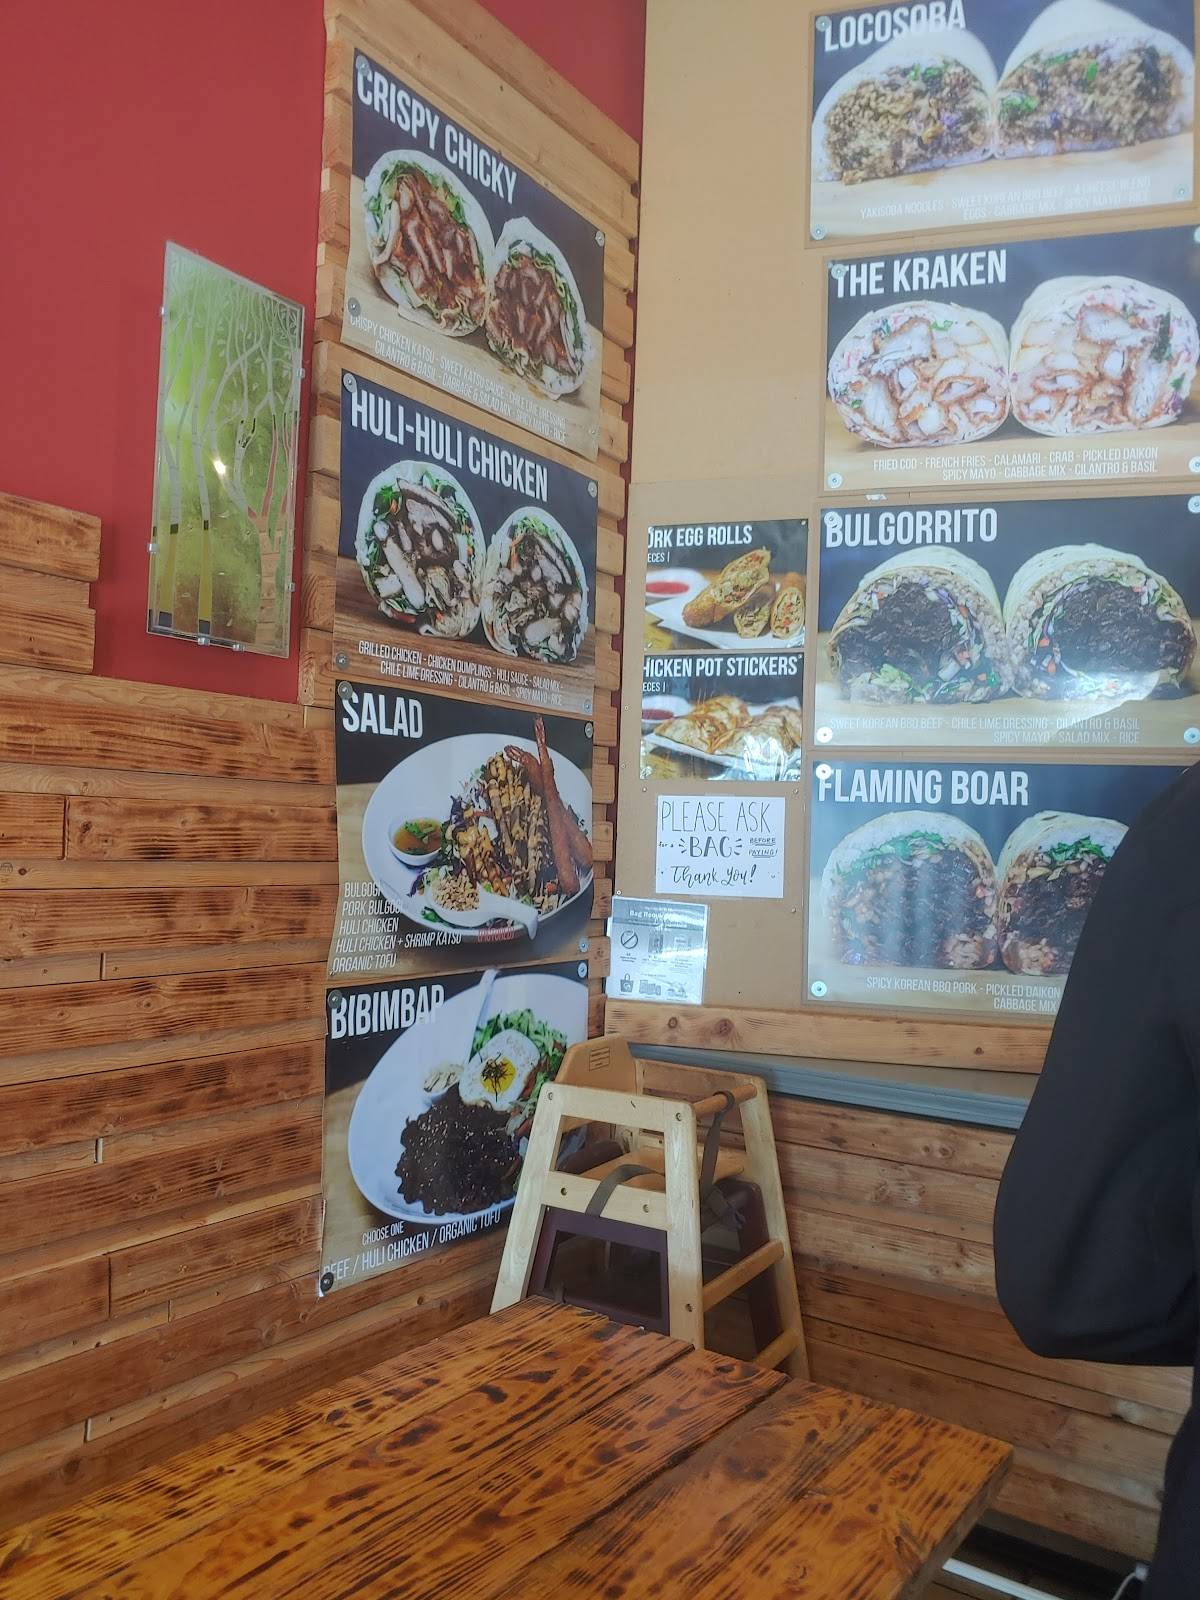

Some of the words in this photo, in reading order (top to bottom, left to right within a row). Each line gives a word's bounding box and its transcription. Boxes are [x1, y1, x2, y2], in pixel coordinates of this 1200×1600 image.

[825, 0, 966, 52] LOCOSOBA
[357, 68, 440, 151] CRISPY
[445, 124, 517, 205] CHICKY
[832, 262, 885, 298] THE
[893, 249, 1007, 293] KRAKEN
[379, 326, 410, 352] CHICKEN
[412, 342, 435, 363] KATSU
[440, 356, 463, 377] SWEET
[464, 367, 485, 387] KATSU
[375, 340, 411, 368] CILANTRO
[411, 360, 417, 371] &
[417, 361, 437, 381] BASIL
[442, 373, 473, 400] CABBAGE
[479, 391, 500, 411] SALAD
[351, 387, 463, 469] HULI-HULI
[468, 436, 547, 502] CHICKEN
[873, 459, 898, 471] FRIED
[900, 458, 917, 470] COD
[925, 456, 959, 469] FRENCH
[961, 455, 985, 468] FRIES
[994, 451, 1041, 466] CALAMARI
[1049, 450, 1074, 463] CRAB
[1082, 448, 1121, 462] PICKLED
[1123, 446, 1159, 460] DAIKON
[942, 469, 968, 481] SPICY
[969, 467, 996, 480] MAYO
[1004, 465, 1046, 479] CABBAGE
[1048, 465, 1066, 477] MIX
[1074, 461, 1119, 475] CILANTRO
[1122, 461, 1128, 474] &
[1130, 460, 1157, 473] BASIL
[676, 527, 704, 547] EGG
[707, 525, 753, 546] ROLLS
[825, 508, 998, 548] BULGORRITO
[359, 640, 390, 659] GRILLED
[391, 646, 422, 665] CHICKEN
[427, 654, 456, 671] CHICKEN
[457, 660, 492, 679] DUMPLINGS
[496, 668, 510, 682] HULI
[511, 671, 529, 686] SAUCE
[532, 676, 549, 691] SALAD
[695, 657, 723, 677] POT
[726, 656, 798, 676] STICKERS
[380, 661, 401, 677] CHILE
[402, 665, 420, 680] LIME
[420, 667, 453, 686] DRESSING
[458, 675, 489, 693] CILANTRO
[489, 681, 494, 694] &
[494, 682, 511, 697] BASIL
[515, 686, 532, 700] SPICY
[532, 688, 548, 704] MAYO
[342, 691, 423, 739] SALAD
[830, 717, 860, 729] SWEET
[862, 717, 899, 729] KOREAN
[921, 716, 943, 729] BEEF
[951, 717, 977, 729] CHILE
[979, 717, 1001, 729] LIME
[1004, 717, 1048, 729] DRESSING
[1104, 719, 1110, 729] &
[1113, 717, 1139, 730] BASIL
[993, 731, 1020, 744] SPICY
[1022, 731, 1050, 744] MAYO
[1058, 731, 1089, 744] SALAD
[1092, 731, 1110, 744] MIX
[1119, 731, 1139, 744] RICE
[818, 769, 943, 804] FLAMING
[951, 770, 1030, 806] BOAR
[661, 800, 728, 832] PLEASE
[736, 801, 771, 833] ASK
[689, 836, 733, 858] BAG
[748, 848, 778, 857] PAYING!
[749, 837, 776, 845] BEFORE
[670, 865, 719, 889] Thank
[342, 900, 367, 917] PORK
[368, 899, 402, 915] BULGOG
[339, 920, 361, 936] HULI
[361, 918, 399, 934] CHICKEN
[335, 938, 357, 954] HULI
[358, 935, 396, 952] CHICKEN
[404, 932, 436, 948] SHRIMP
[435, 932, 462, 946] KATSU
[332, 956, 373, 974] ORGANIC
[375, 953, 397, 969] TOFU
[866, 976, 892, 989] SPICY
[894, 977, 932, 992] KOREAN
[932, 980, 951, 993] BBQ
[952, 981, 977, 994] PORK
[985, 983, 1024, 997] PICKLED
[1025, 985, 1061, 999] DAIKON
[331, 984, 445, 1040] BIBIMBAP
[993, 998, 1036, 1012] CABBAGE
[1039, 999, 1057, 1013] MIX
[361, 1249, 385, 1272] HULI
[387, 1231, 429, 1262] CHICKEN
[438, 1216, 478, 1244] ORGANIC
[480, 1209, 501, 1230] TOFU
[362, 1228, 389, 1247] CHOOSE
[390, 1220, 406, 1236] ONE
